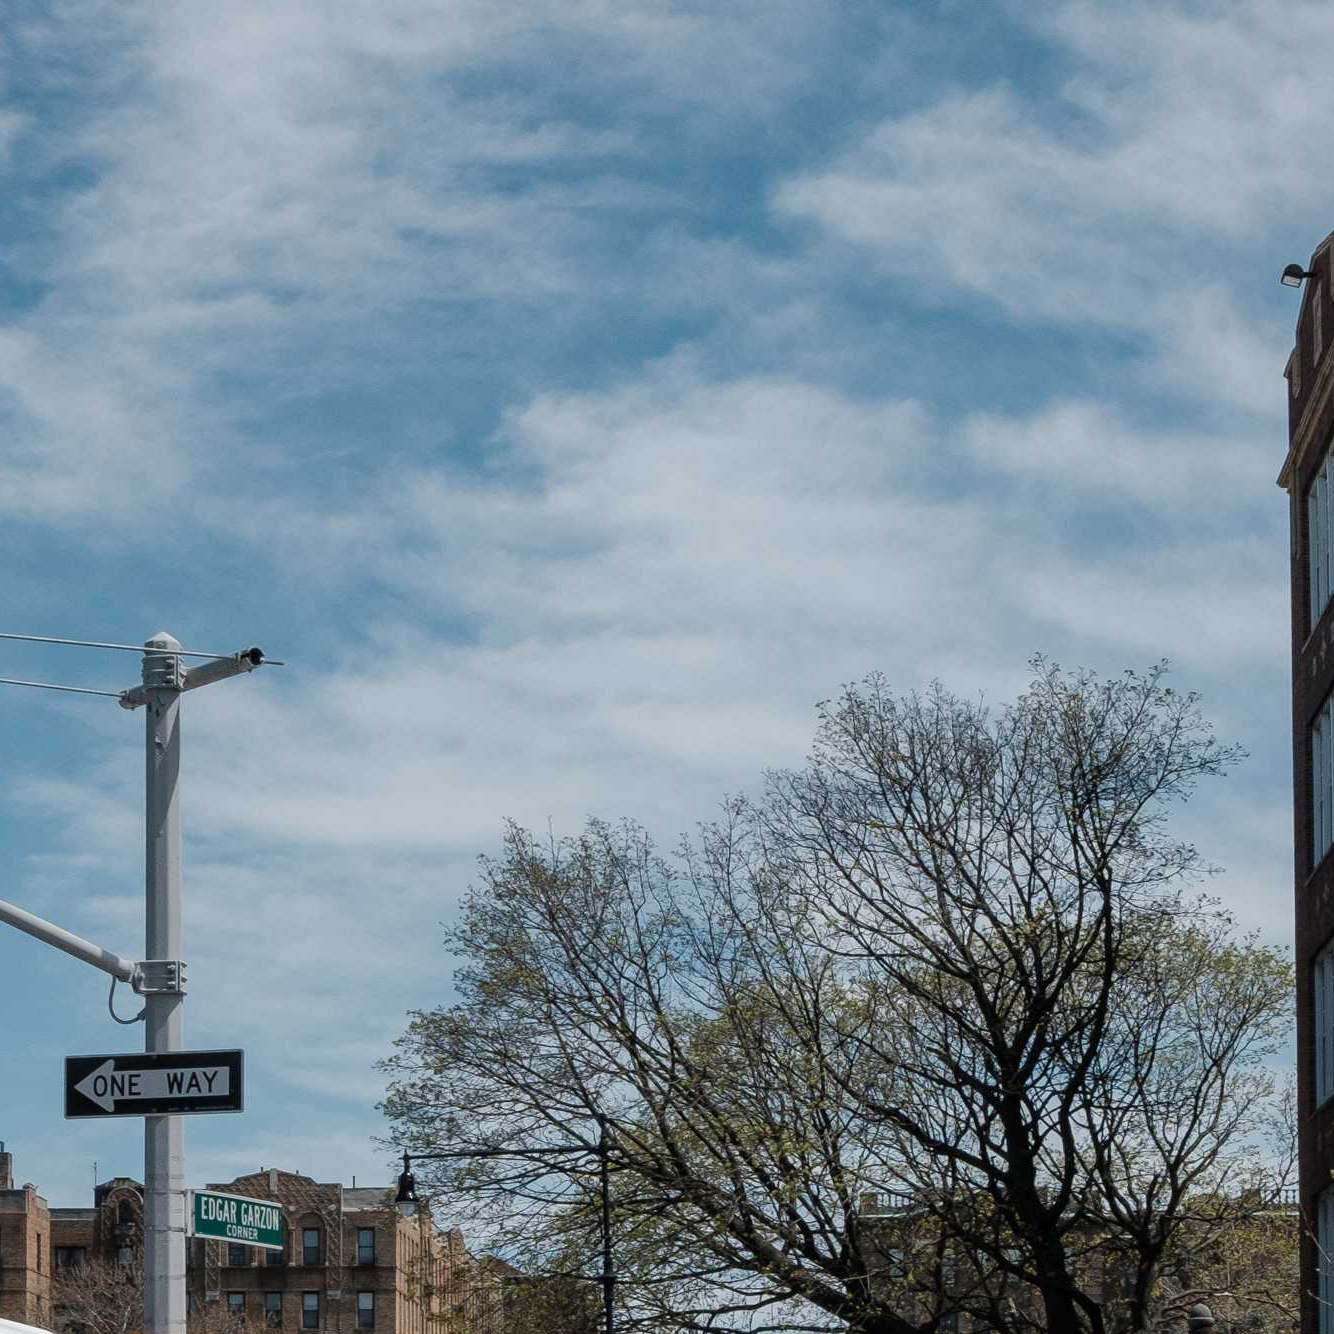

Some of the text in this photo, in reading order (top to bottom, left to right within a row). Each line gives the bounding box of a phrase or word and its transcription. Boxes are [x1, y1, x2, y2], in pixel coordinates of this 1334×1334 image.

[93, 1070, 219, 1098] ONE WAY
[200, 1197, 280, 1231] EDGAR GARZON
[226, 1224, 259, 1241] CORNER
